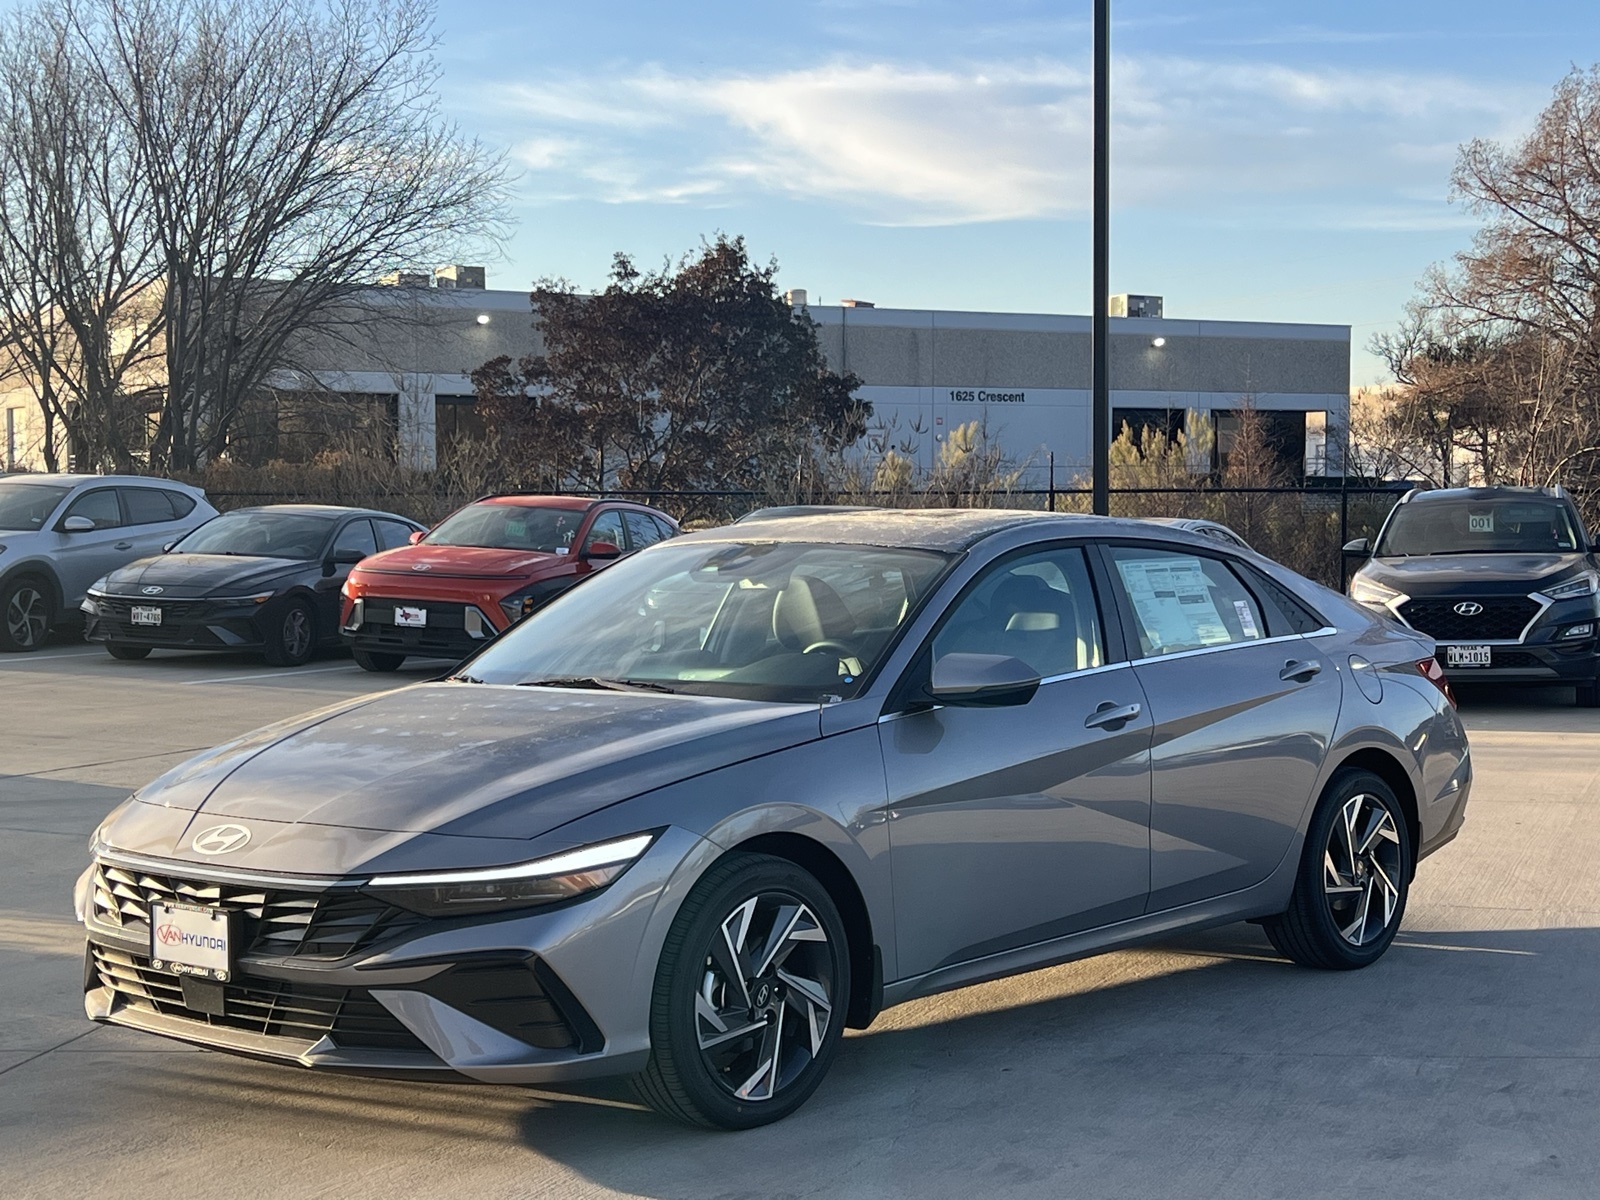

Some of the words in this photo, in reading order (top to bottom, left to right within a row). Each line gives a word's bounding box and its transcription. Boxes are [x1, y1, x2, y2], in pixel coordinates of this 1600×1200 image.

[950, 391, 975, 402] 1625
[978, 391, 1025, 402] Crescent
[1471, 518, 1490, 528] 001
[158, 925, 181, 945] VAN
[181, 933, 226, 951] HYUNDAI
